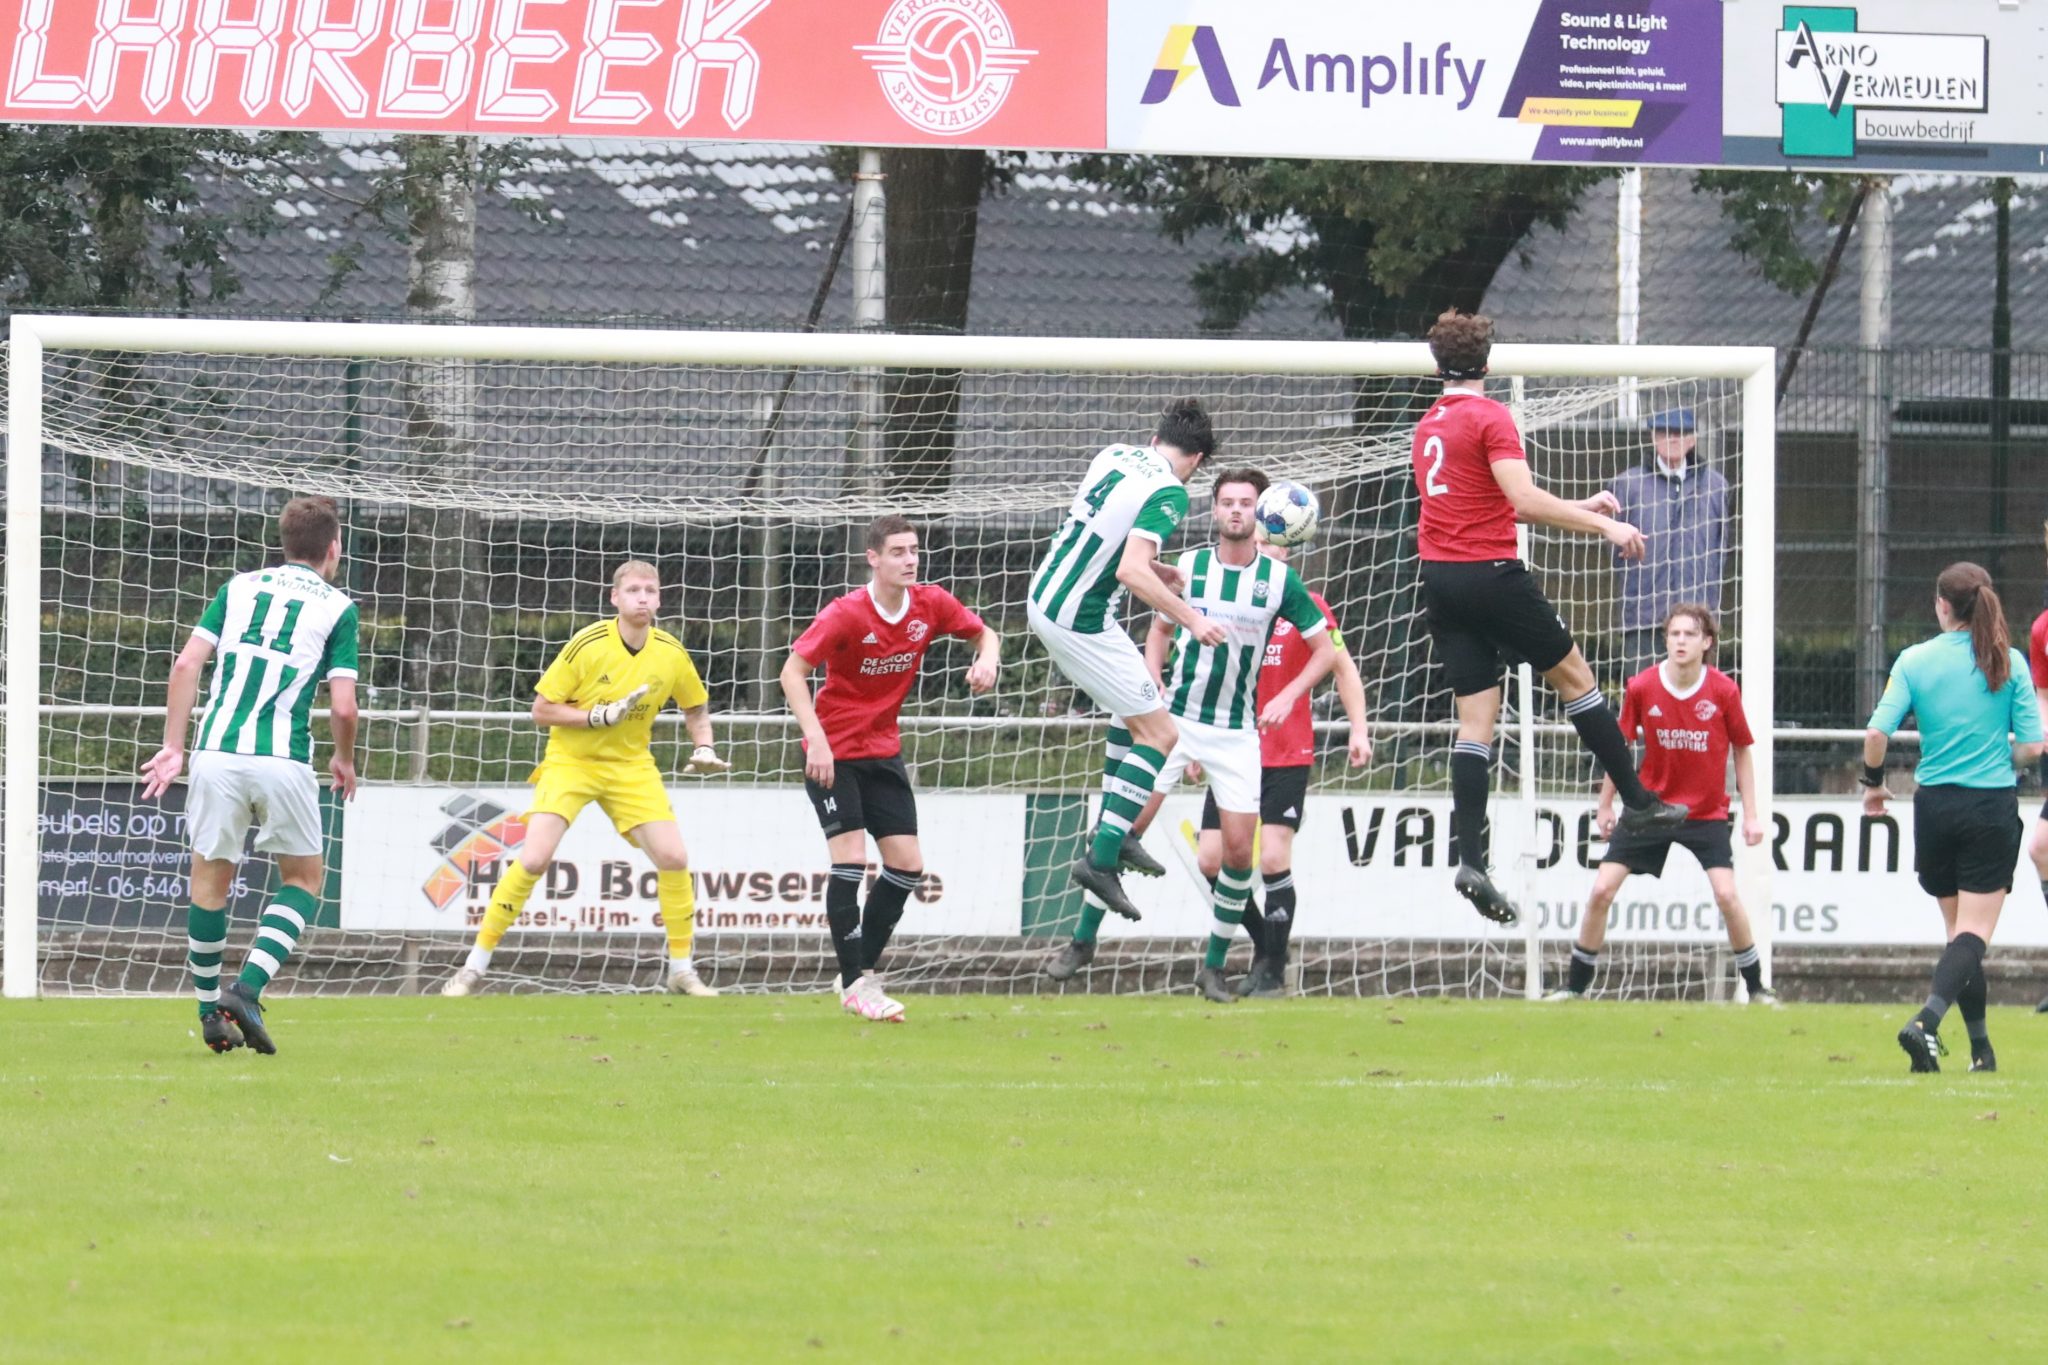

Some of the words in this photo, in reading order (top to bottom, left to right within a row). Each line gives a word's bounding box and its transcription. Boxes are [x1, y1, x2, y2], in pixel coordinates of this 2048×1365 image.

[1560, 12, 1610, 28] Sound
[1614, 14, 1624, 28] &
[1627, 14, 1668, 32] Light
[1560, 35, 1650, 54] Technology
[1786, 19, 1878, 69] ARNO
[3, 0, 770, 130] LAARBEEK
[1257, 38, 1486, 111] Amplify
[1559, 65, 1614, 75] Professioneel
[892, 82, 998, 126] SPECIALIST
[1815, 67, 1977, 118] VERMEULEN
[1560, 137, 1643, 148] www.amplifybv.nl
[1865, 119, 1977, 144] bouwbedrijf
[1423, 435, 1449, 497] 2
[1084, 469, 1126, 518] 4
[277, 578, 330, 600] WIJMAN
[240, 591, 305, 656] 11
[863, 657, 879, 667] DE
[1656, 728, 1670, 738] DE
[1671, 729, 1709, 740] GROOT
[823, 796, 838, 814] 14
[38, 809, 120, 835] eubels
[129, 815, 167, 839] op
[1341, 807, 1491, 867] VA
[39, 877, 88, 896] mert
[467, 860, 579, 900] HD
